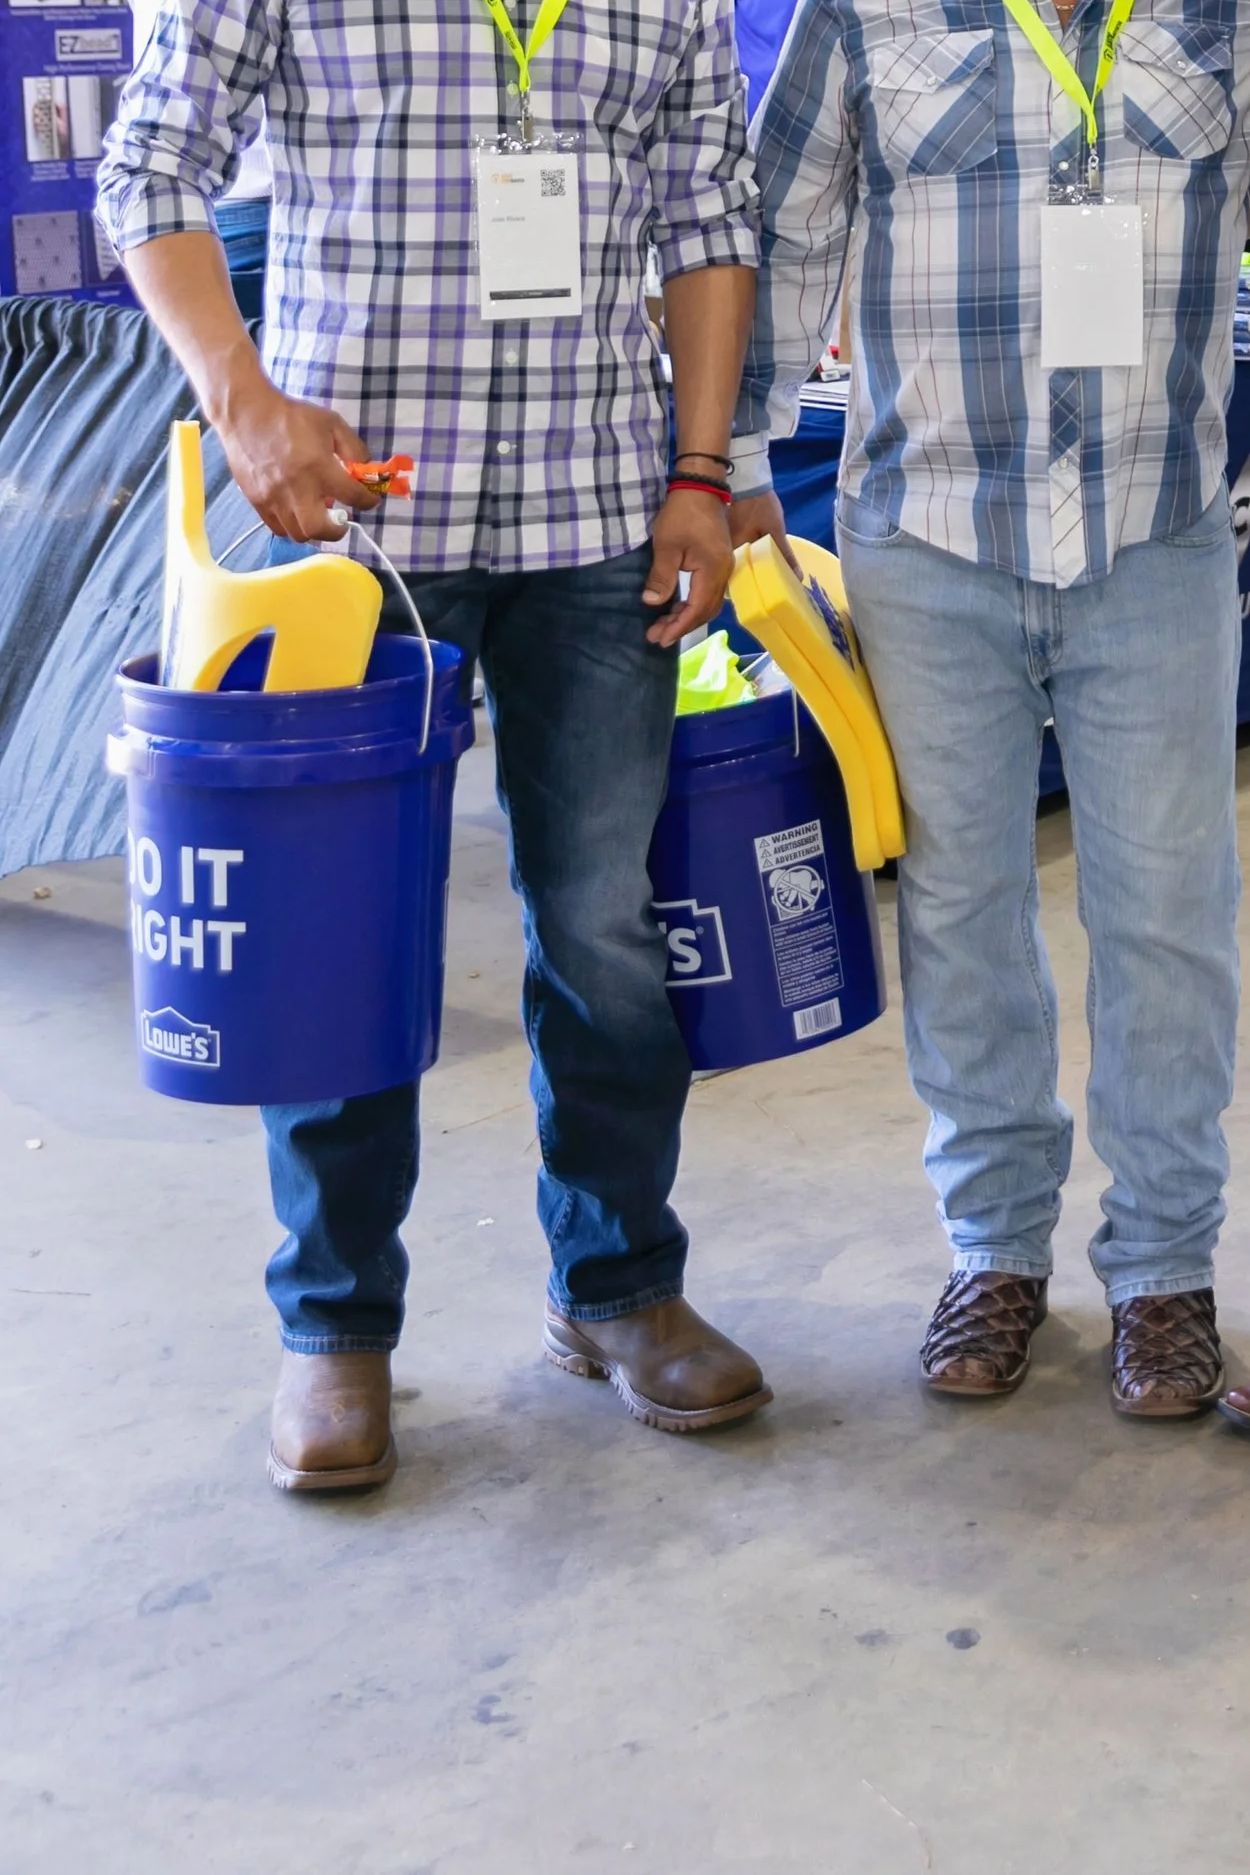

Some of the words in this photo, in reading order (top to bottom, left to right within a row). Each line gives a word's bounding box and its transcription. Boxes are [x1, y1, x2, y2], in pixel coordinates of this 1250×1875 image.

[771, 822, 819, 845] WARNING
[773, 833, 820, 856] AVERTISSEMENT
[775, 844, 821, 866] ADVERTENCIA
[181, 845, 244, 907] IT
[131, 897, 247, 971] IGHT
[145, 1018, 210, 1061] LOWE'S
